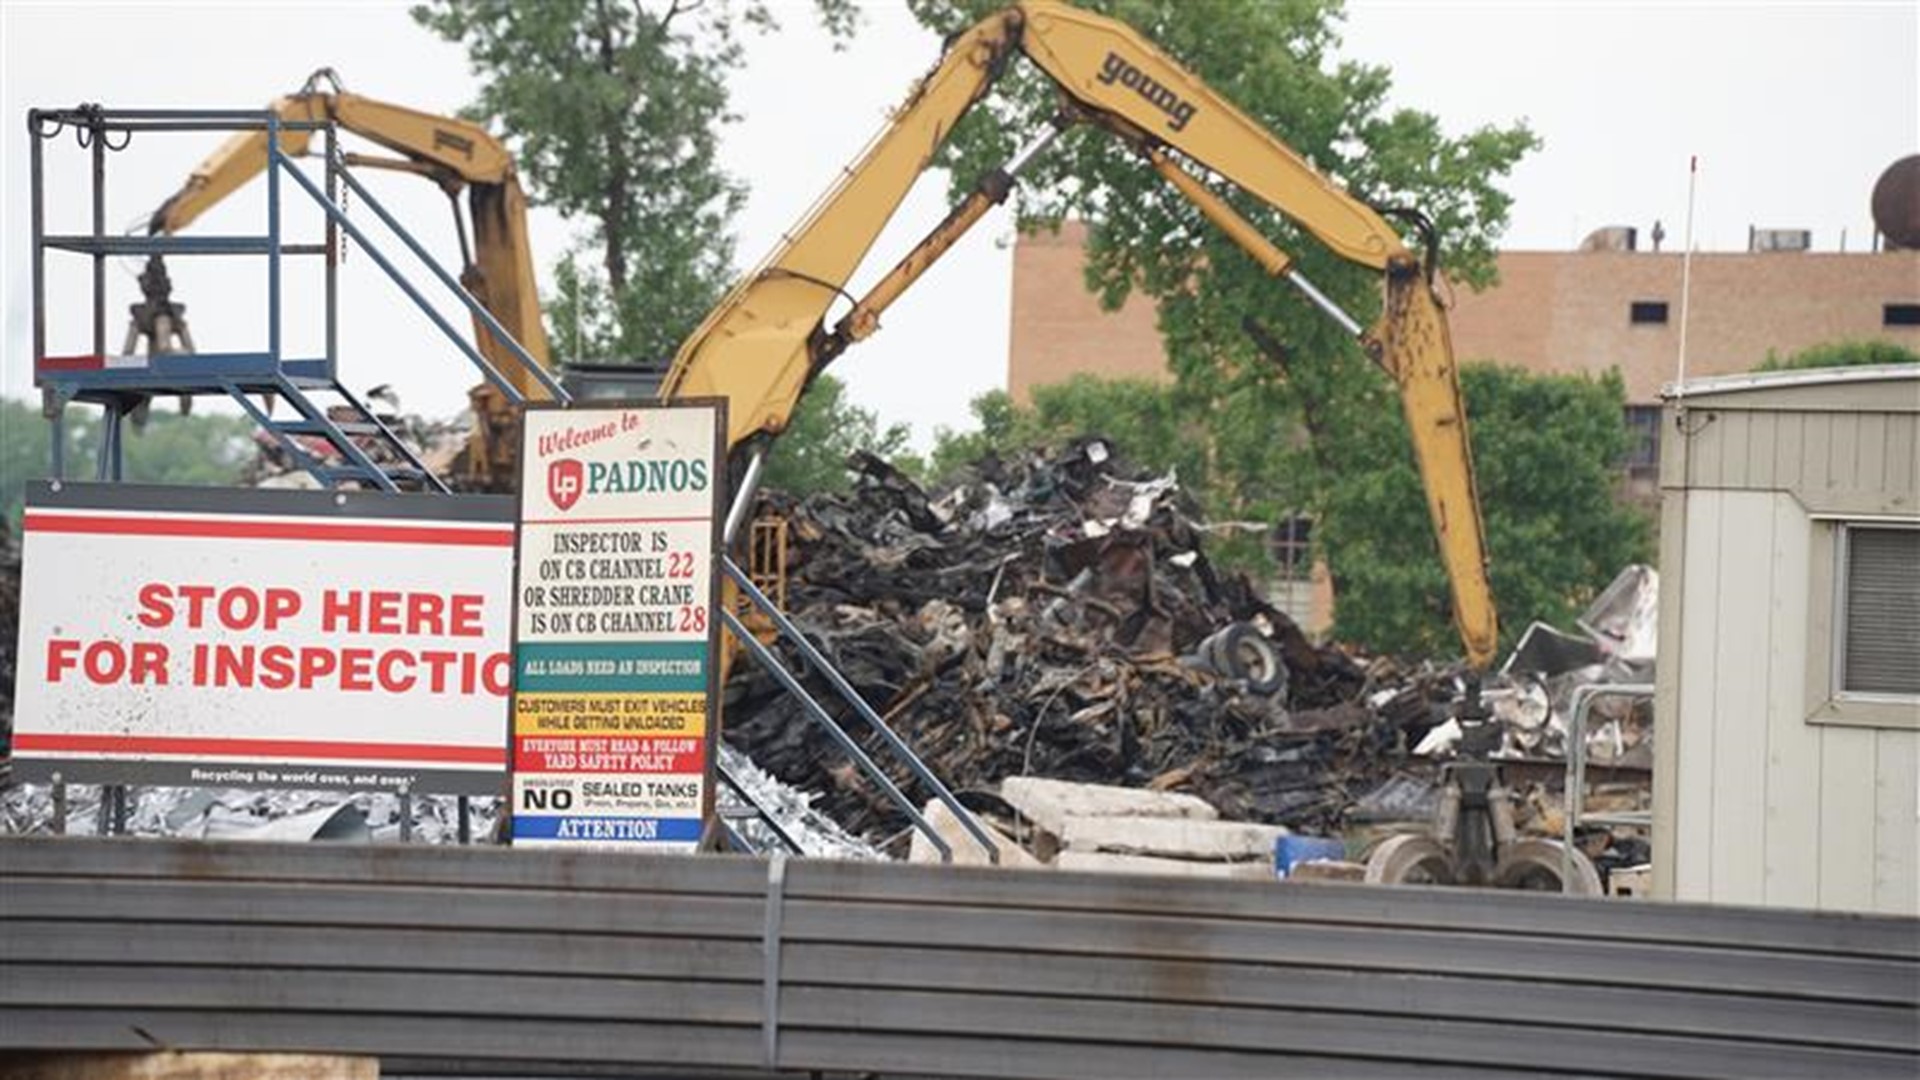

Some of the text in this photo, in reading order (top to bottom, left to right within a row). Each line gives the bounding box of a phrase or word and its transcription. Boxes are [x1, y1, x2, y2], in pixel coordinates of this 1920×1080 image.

[1096, 51, 1198, 132] young
[538, 412, 639, 457] Welcome to
[587, 459, 708, 494] PADNOS
[553, 531, 668, 553] INSPECTOR IS
[539, 551, 695, 581] ON CB CHANNEL 22
[524, 584, 694, 608] OR SHREDDER CRANE
[138, 584, 484, 637] STOP HERE
[531, 606, 706, 634] IS ON CB CHANNEL 28
[46, 640, 170, 685] FOR
[525, 661, 546, 676] ALL
[619, 660, 634, 675] AN
[518, 699, 706, 714] CUSTOMERS MUST EXIT VEHICLES
[537, 716, 685, 730] WHILE GETTING UNLOADED
[579, 739, 608, 752] MUST
[545, 753, 675, 770] YARD SAFETY POLICY
[191, 769, 253, 783] Recycling
[257, 771, 277, 781] the
[281, 772, 317, 783] world
[353, 774, 377, 785] and
[523, 789, 573, 810] NO
[582, 782, 698, 798] SEALED TANKS
[557, 819, 658, 839] ATTENTION
